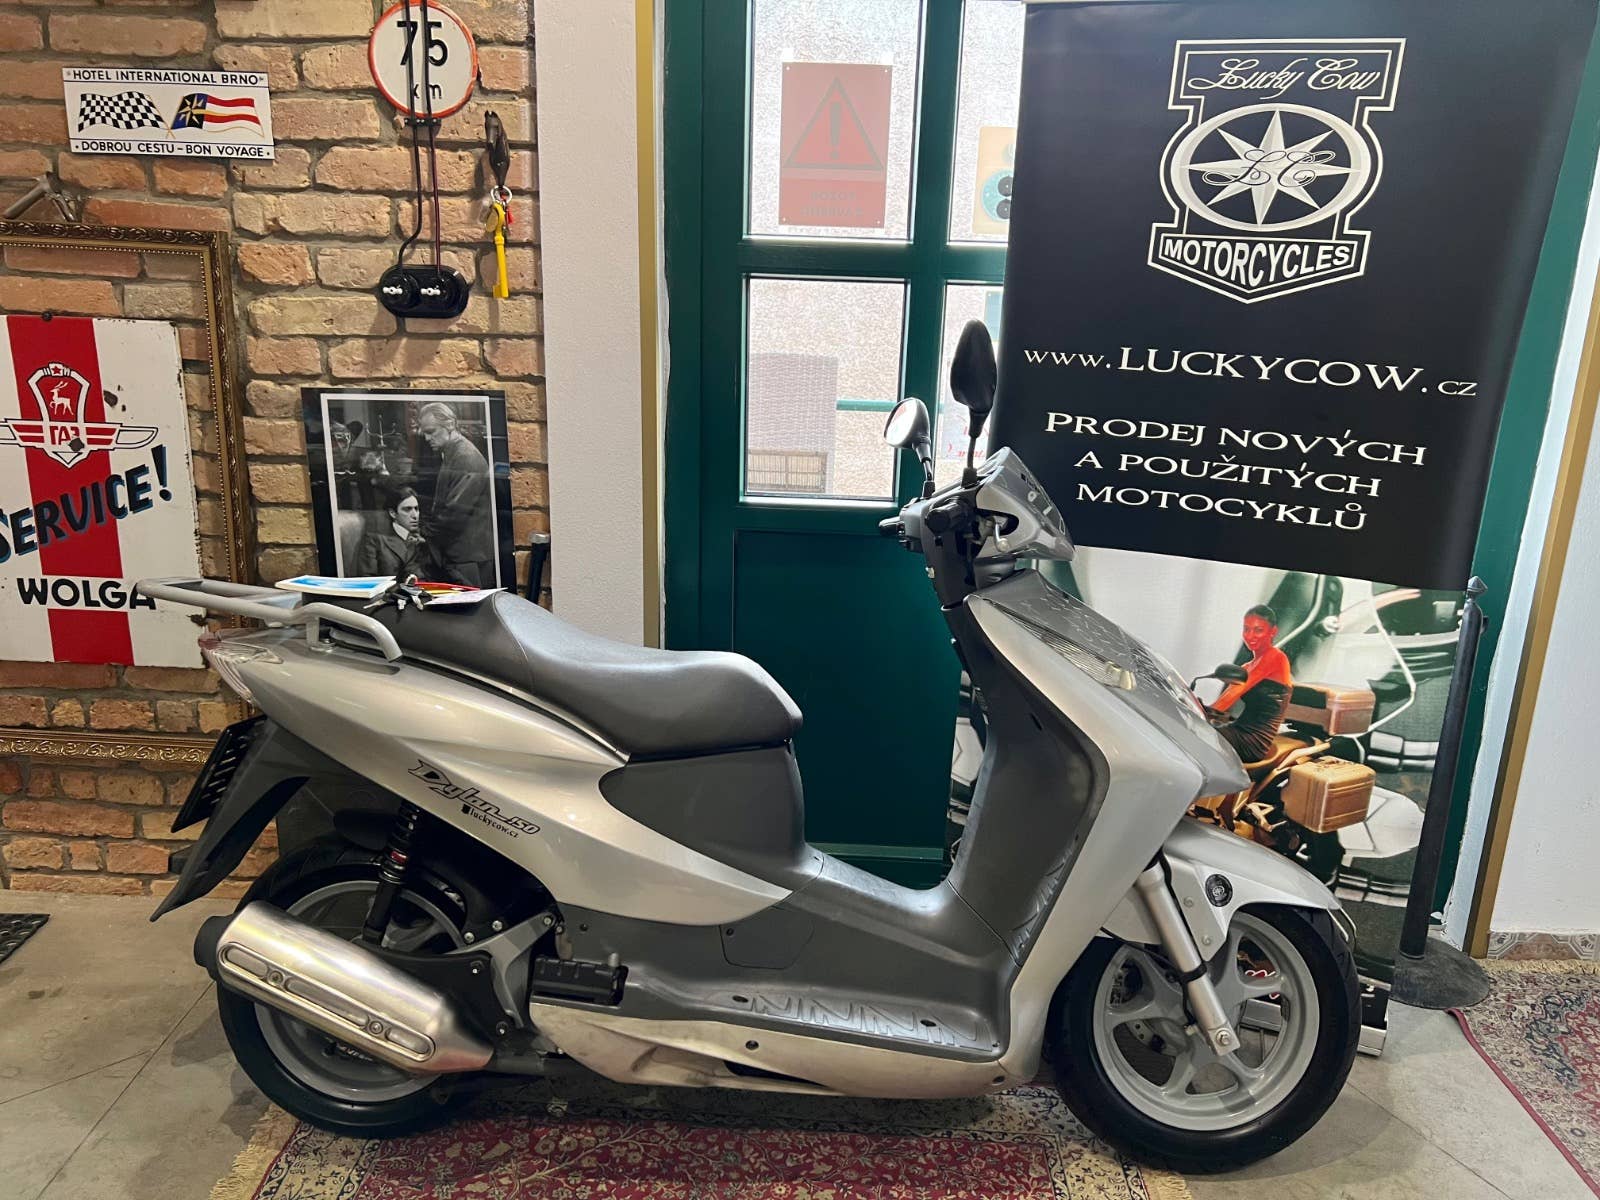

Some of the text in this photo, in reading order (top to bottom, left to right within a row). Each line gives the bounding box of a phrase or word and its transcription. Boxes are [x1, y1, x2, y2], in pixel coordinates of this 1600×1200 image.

[396, 20, 448, 67] 75
[73, 70, 259, 85] HOTEL INTERNATIONAL BRNO
[1188, 58, 1380, 100] Lucky Cow
[82, 141, 131, 152] DOBROU
[138, 143, 175, 153] CESTU
[186, 144, 212, 155] BON
[216, 145, 264, 157] VOYAGE
[1164, 239, 1350, 287] MOTORCYCLES
[1044, 412, 1427, 467] PRODEJ NOVÝCH
[1074, 450, 1382, 497] A POUŽITÝCH
[1075, 483, 1367, 530] MOTOCYKLŮ
[16, 577, 157, 610] WOLGA
[470, 808, 519, 839] luckycow.cz
